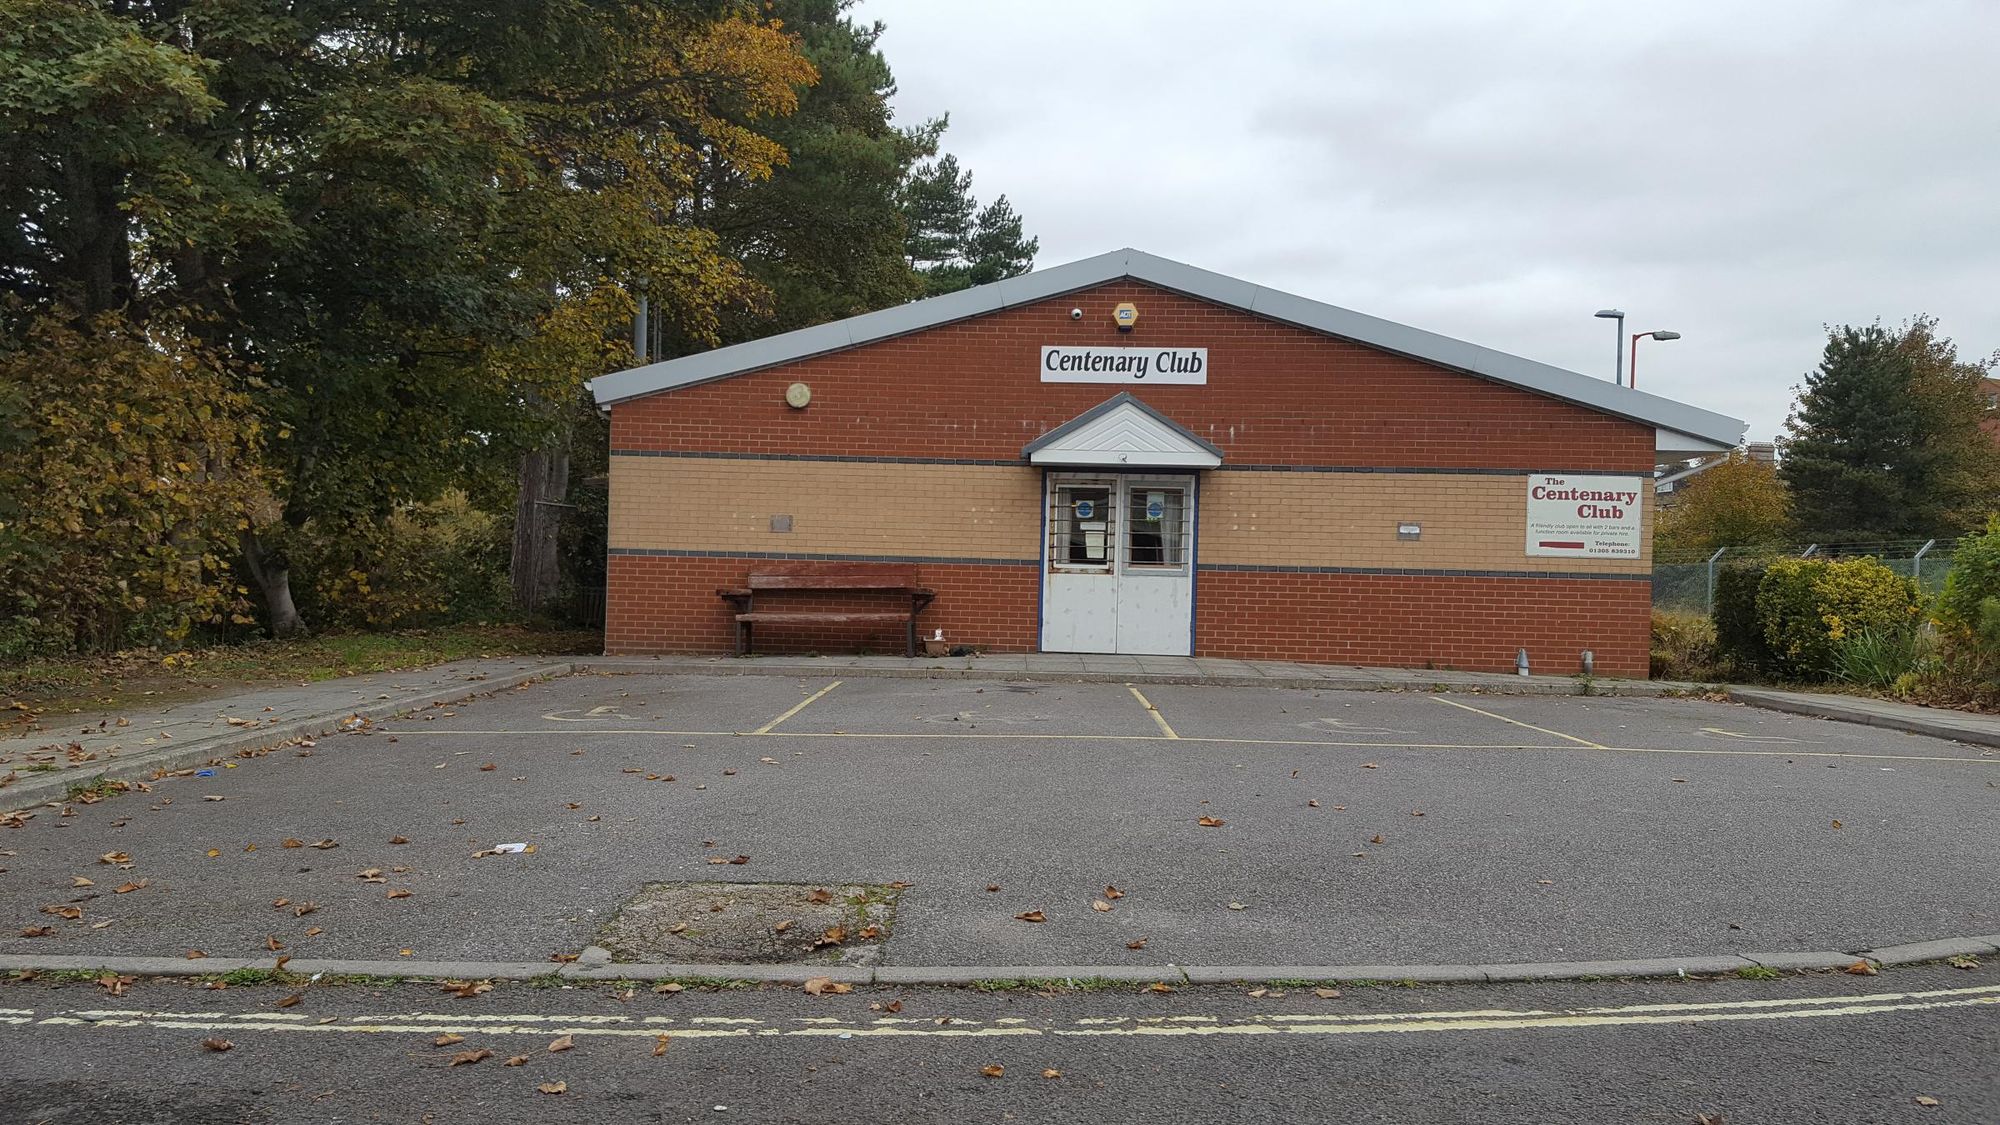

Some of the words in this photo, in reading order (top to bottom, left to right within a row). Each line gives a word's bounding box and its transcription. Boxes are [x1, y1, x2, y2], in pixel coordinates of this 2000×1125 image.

[1120, 310, 1131, 319] ADT
[1045, 349, 1149, 379] Centenary
[1155, 351, 1203, 374] Club
[1545, 477, 1565, 486] The
[1532, 486, 1638, 506] Centenary
[1577, 504, 1624, 519] Club
